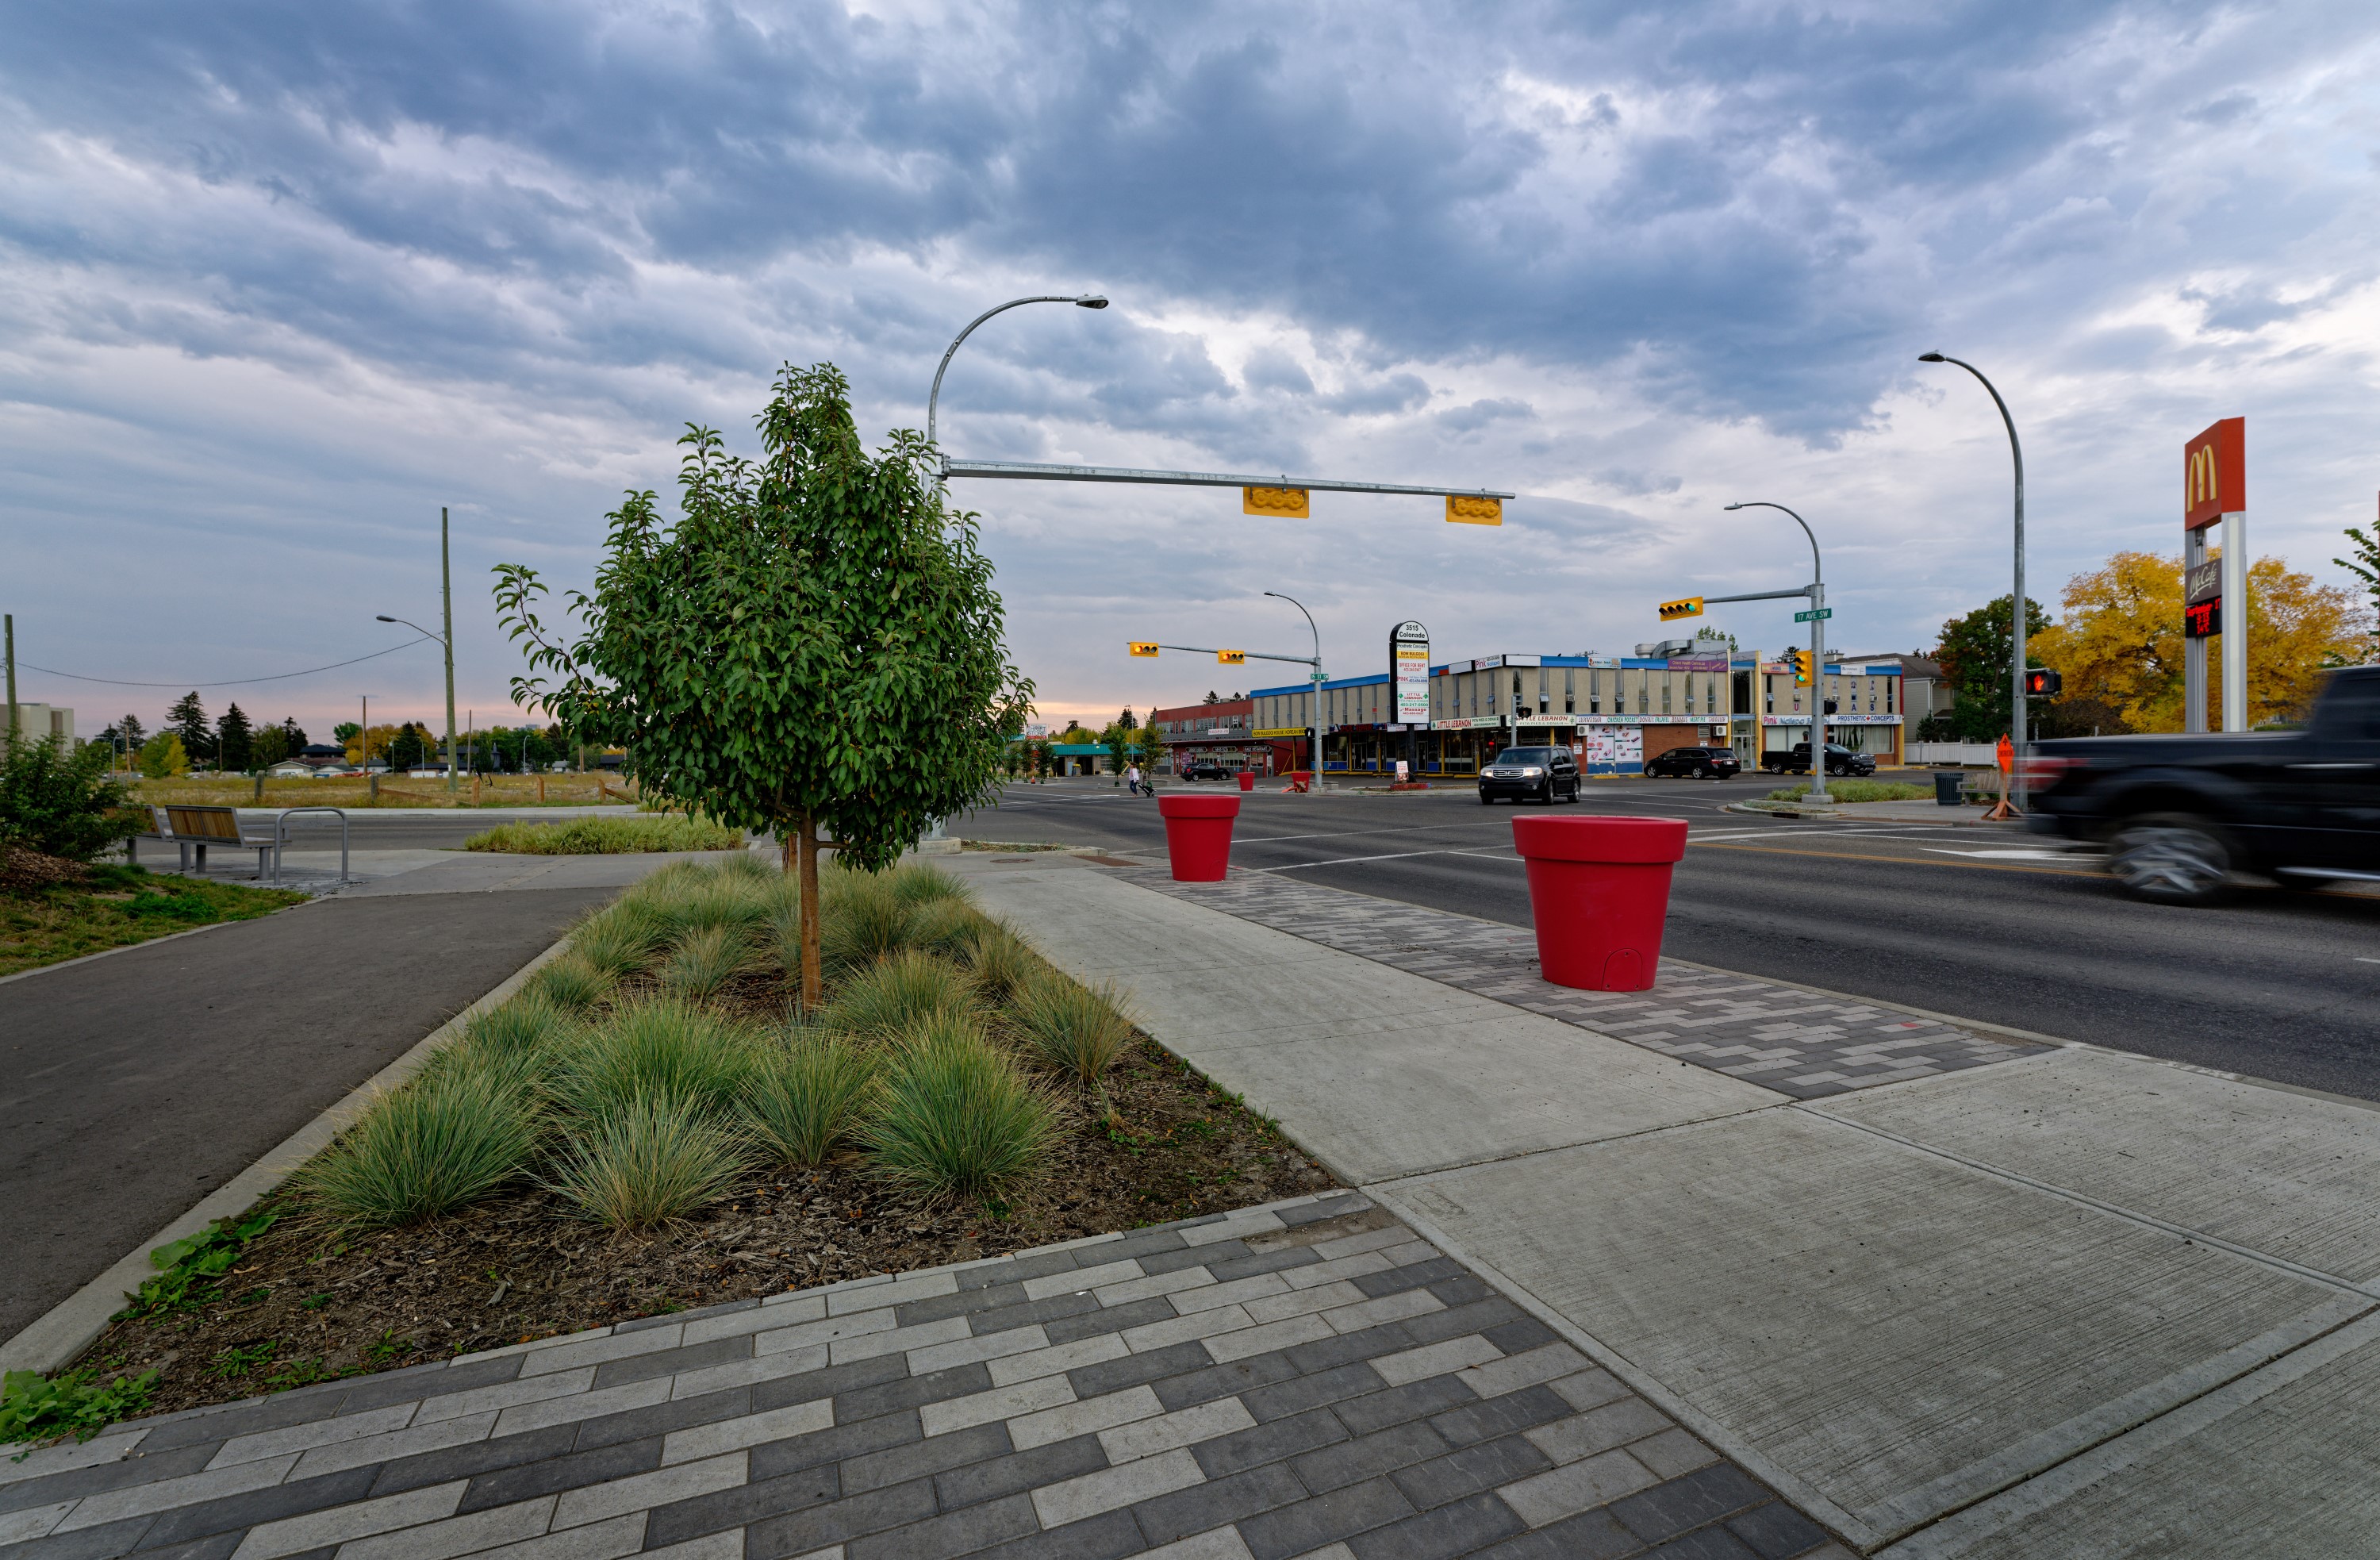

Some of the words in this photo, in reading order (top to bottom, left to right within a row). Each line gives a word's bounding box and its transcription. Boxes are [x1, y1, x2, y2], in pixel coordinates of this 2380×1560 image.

[2190, 562, 2217, 597] McCafé
[1806, 611, 1817, 620] AVE
[1819, 609, 1829, 618] SW
[1476, 659, 1486, 669] Pink
[1451, 719, 1472, 728] LEBANON
[1764, 716, 1777, 724] Pink
